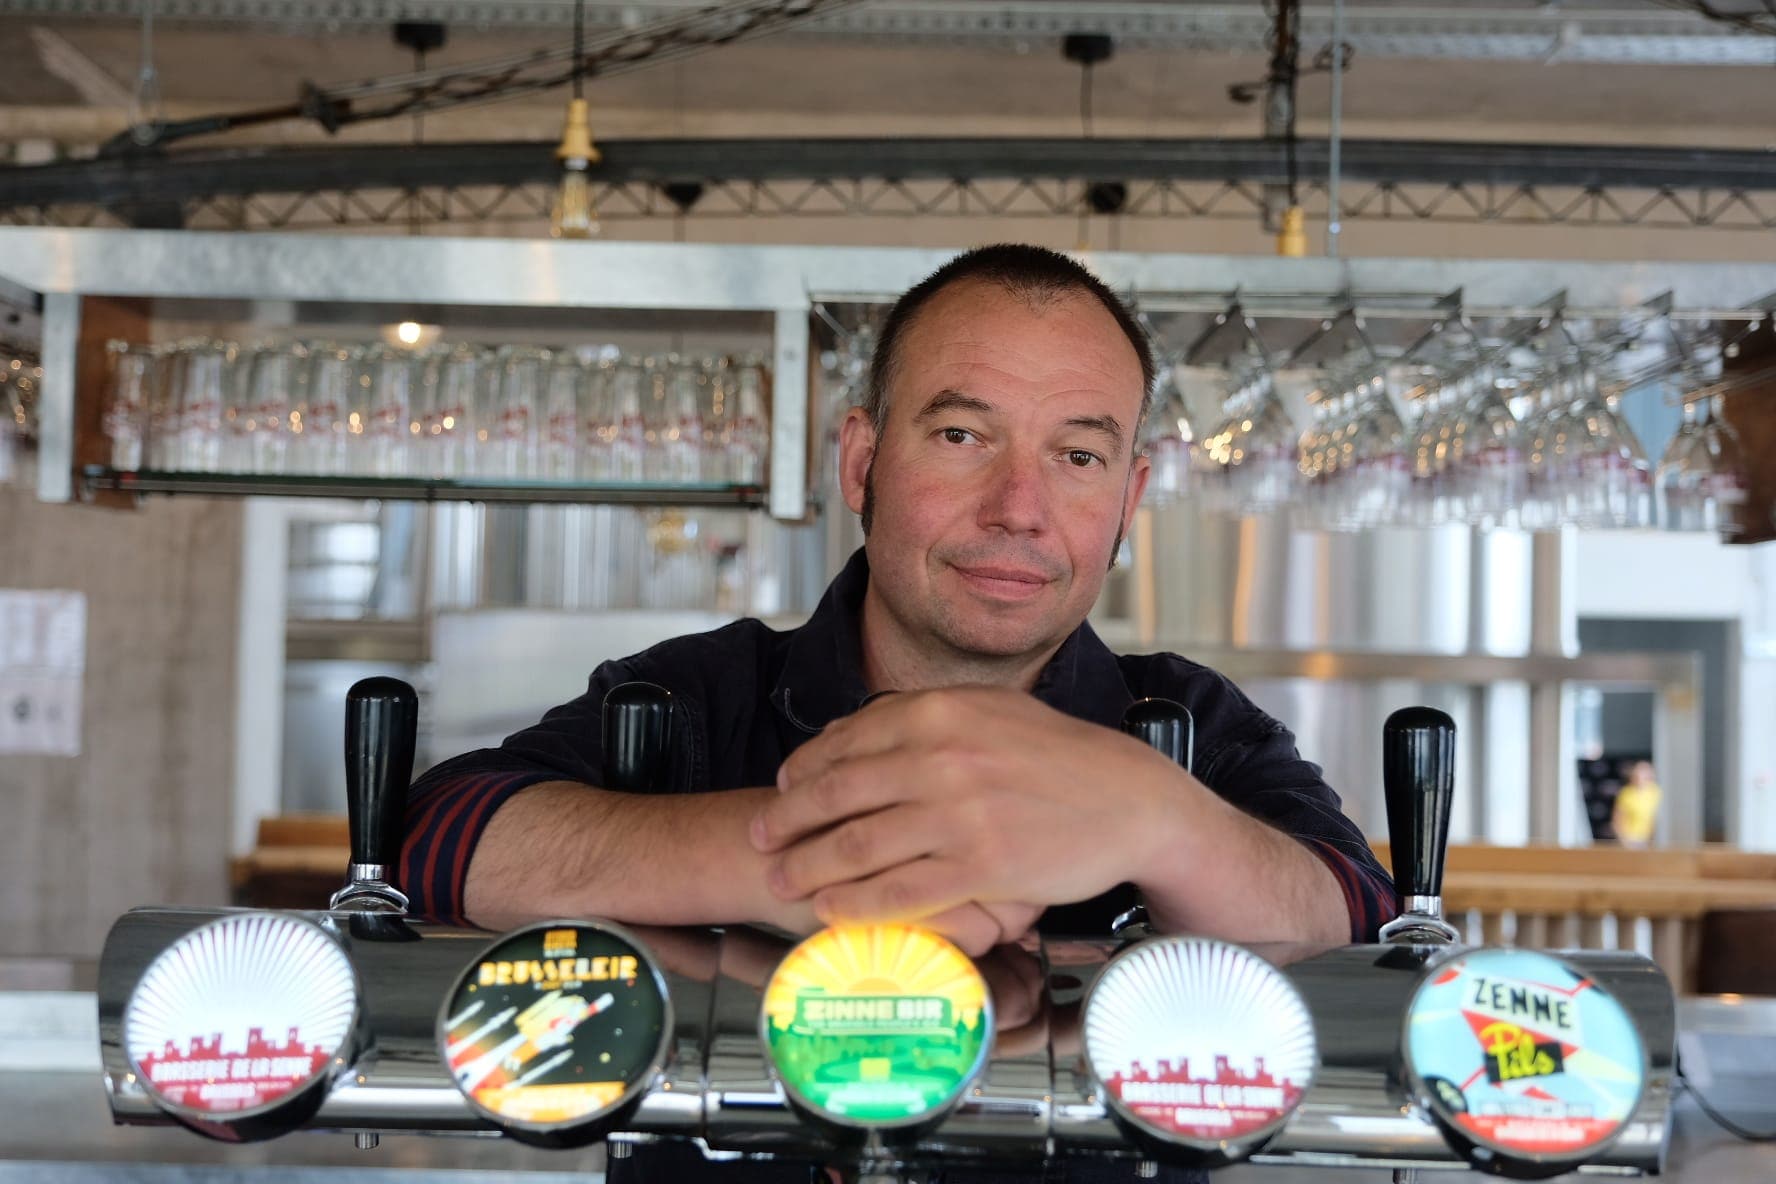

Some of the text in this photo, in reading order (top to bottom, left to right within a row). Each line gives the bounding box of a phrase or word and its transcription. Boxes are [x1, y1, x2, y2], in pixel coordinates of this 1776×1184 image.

[479, 956, 638, 986] BRUSSELEIR
[1473, 978, 1572, 1029] ZENNE
[1480, 1023, 1555, 1080] Pils
